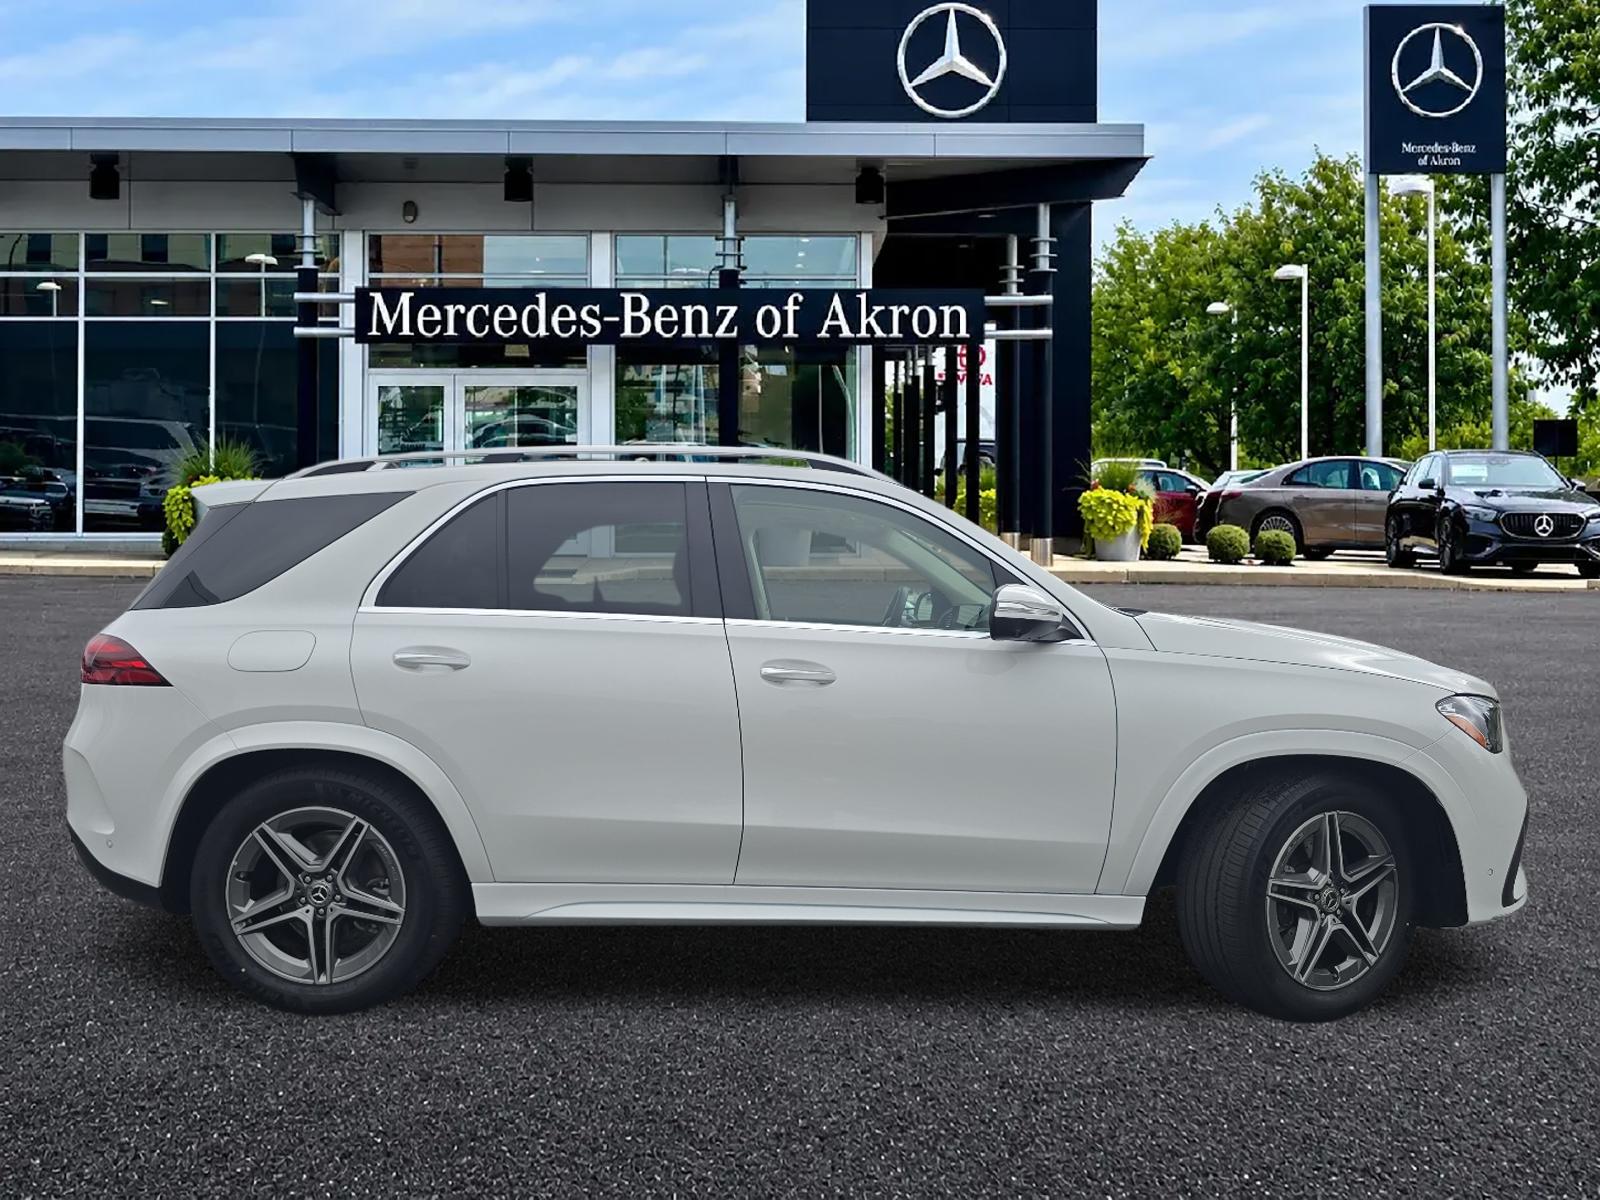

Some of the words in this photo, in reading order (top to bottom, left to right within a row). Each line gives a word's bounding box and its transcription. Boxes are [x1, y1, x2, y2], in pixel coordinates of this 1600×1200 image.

[1401, 141, 1477, 153] Mercedes-Benz
[1417, 154, 1428, 166] of
[1429, 154, 1461, 166] Akron
[367, 289, 739, 341] Mercedes-Benz
[754, 290, 804, 339] of
[817, 289, 970, 341] Akron
